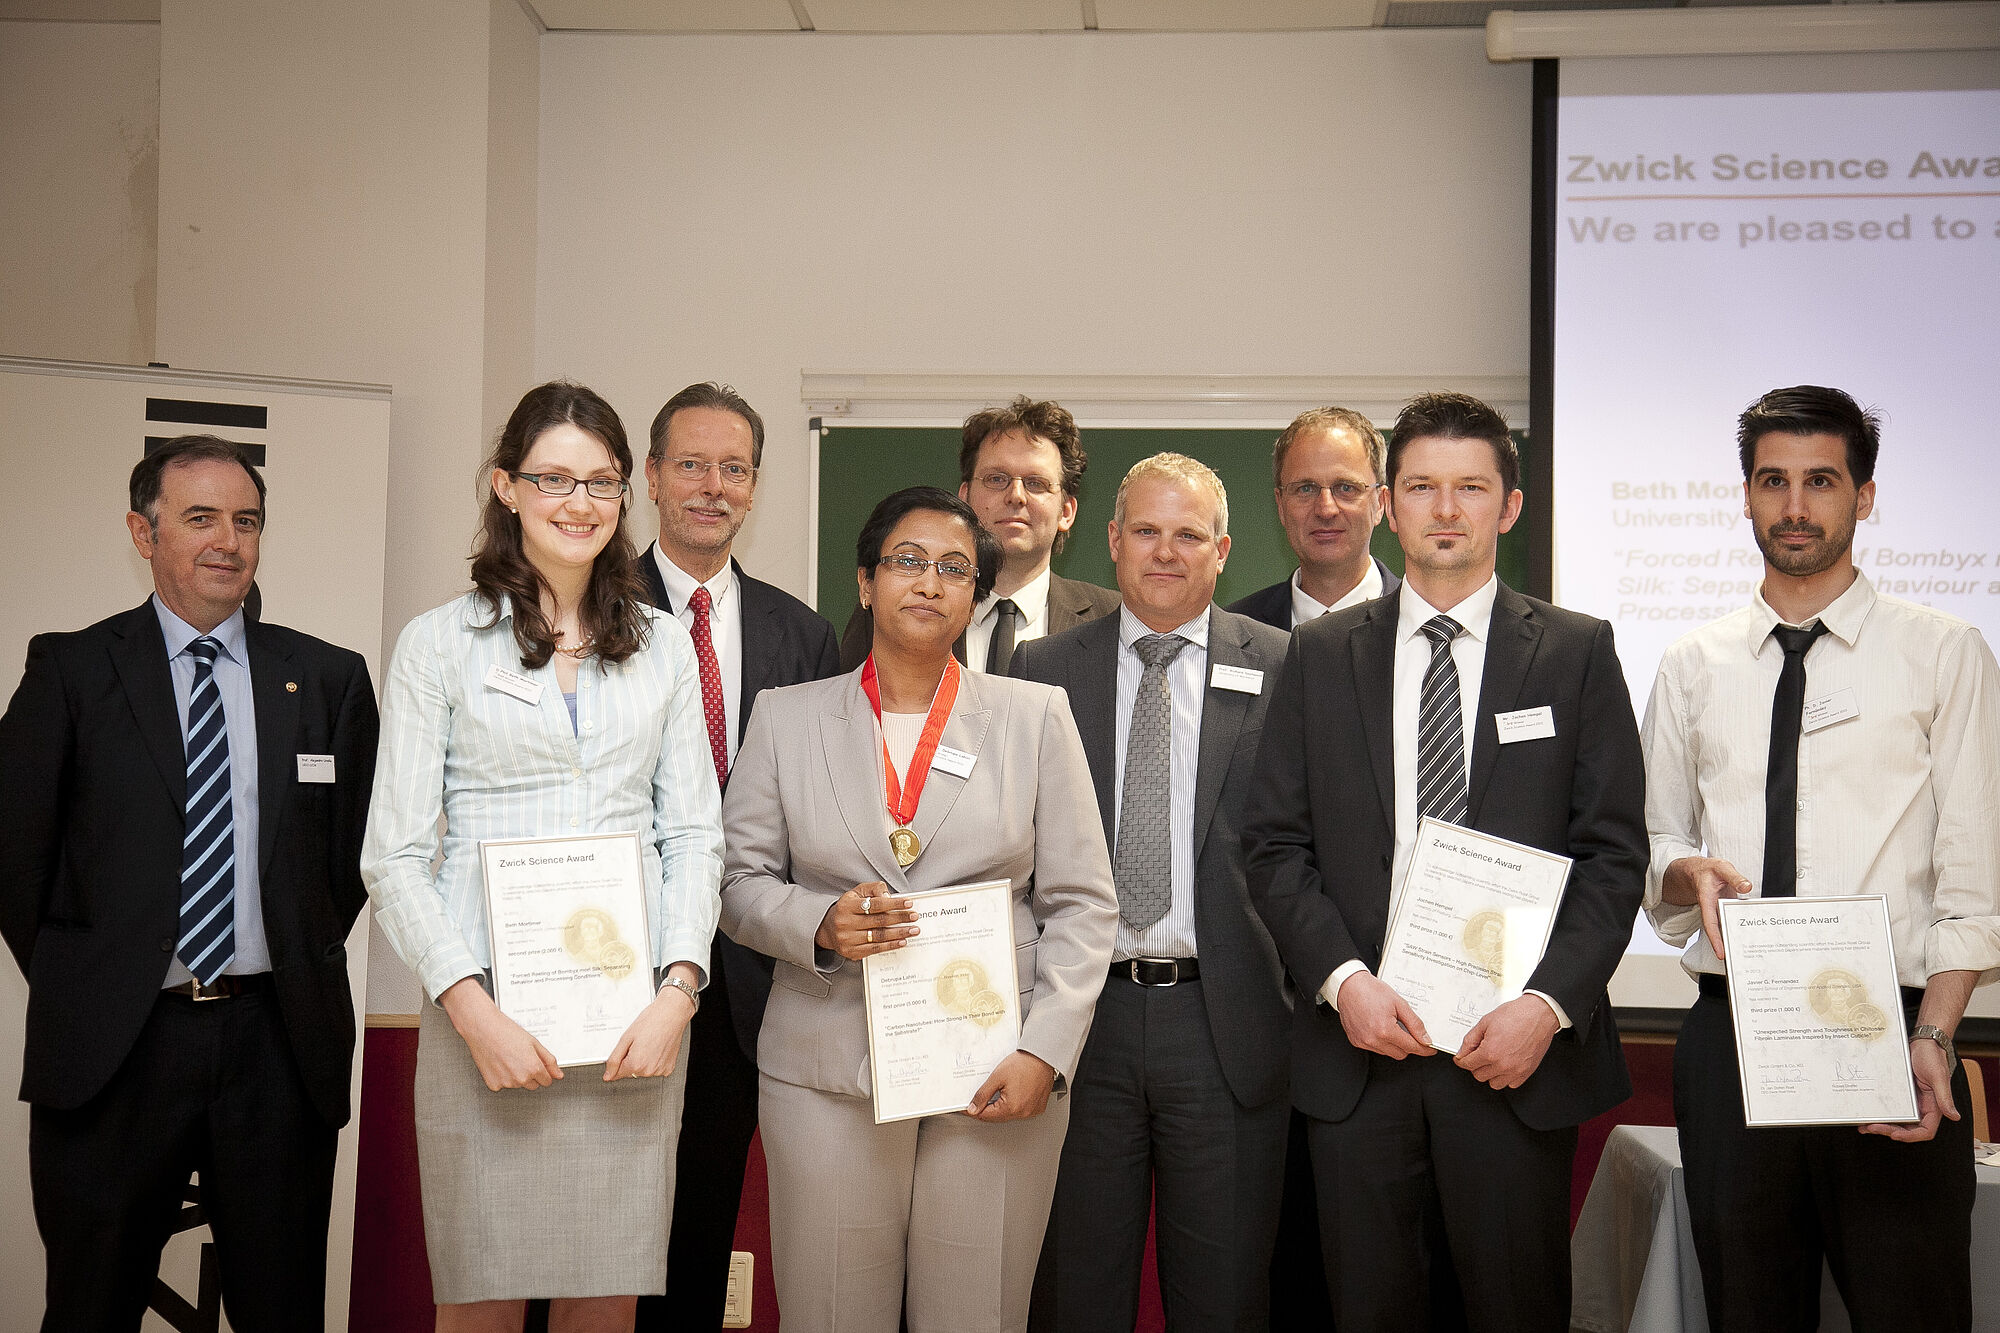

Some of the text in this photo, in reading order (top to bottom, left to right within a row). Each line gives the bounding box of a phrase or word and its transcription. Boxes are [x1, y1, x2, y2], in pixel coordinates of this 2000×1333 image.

[1566, 154, 1696, 183] Zwick
[1711, 153, 1889, 181] Science
[1567, 216, 1637, 243] We
[1653, 220, 1720, 243] are
[1738, 213, 1911, 248] pleased
[1931, 214, 1976, 240] to
[1611, 481, 1677, 500] Beth
[1611, 508, 1742, 531] University
[1852, 547, 1870, 566] f
[1875, 547, 1987, 572] Bombyx
[1616, 576, 1674, 596] Silk:
[499, 853, 595, 868] Zwick Science Award
[1432, 838, 1522, 872] Zwick Science Award
[940, 904, 967, 916] Award
[1739, 915, 1839, 927] Zwick Science Award
